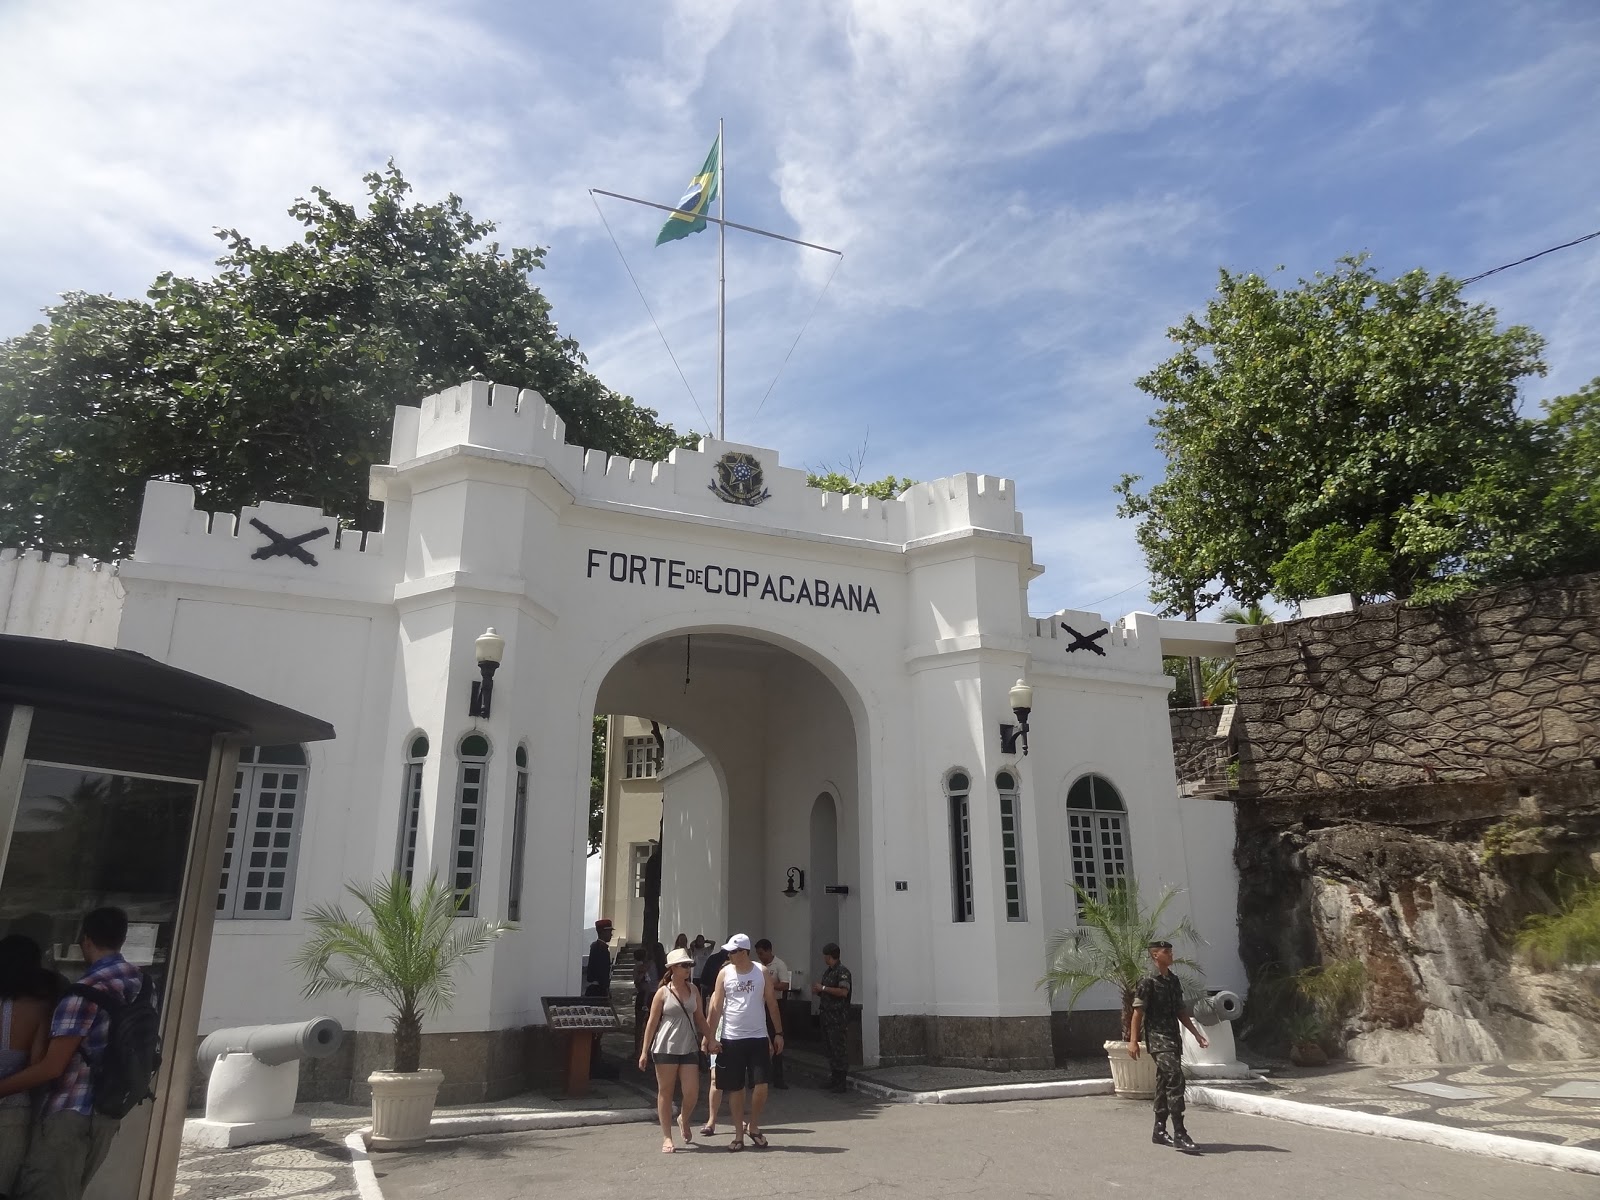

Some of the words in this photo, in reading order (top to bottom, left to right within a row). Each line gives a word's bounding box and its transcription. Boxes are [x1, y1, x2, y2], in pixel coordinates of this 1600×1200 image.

[587, 549, 686, 590] FORTE
[686, 568, 704, 585] DE
[704, 565, 881, 615] COPACABANA
